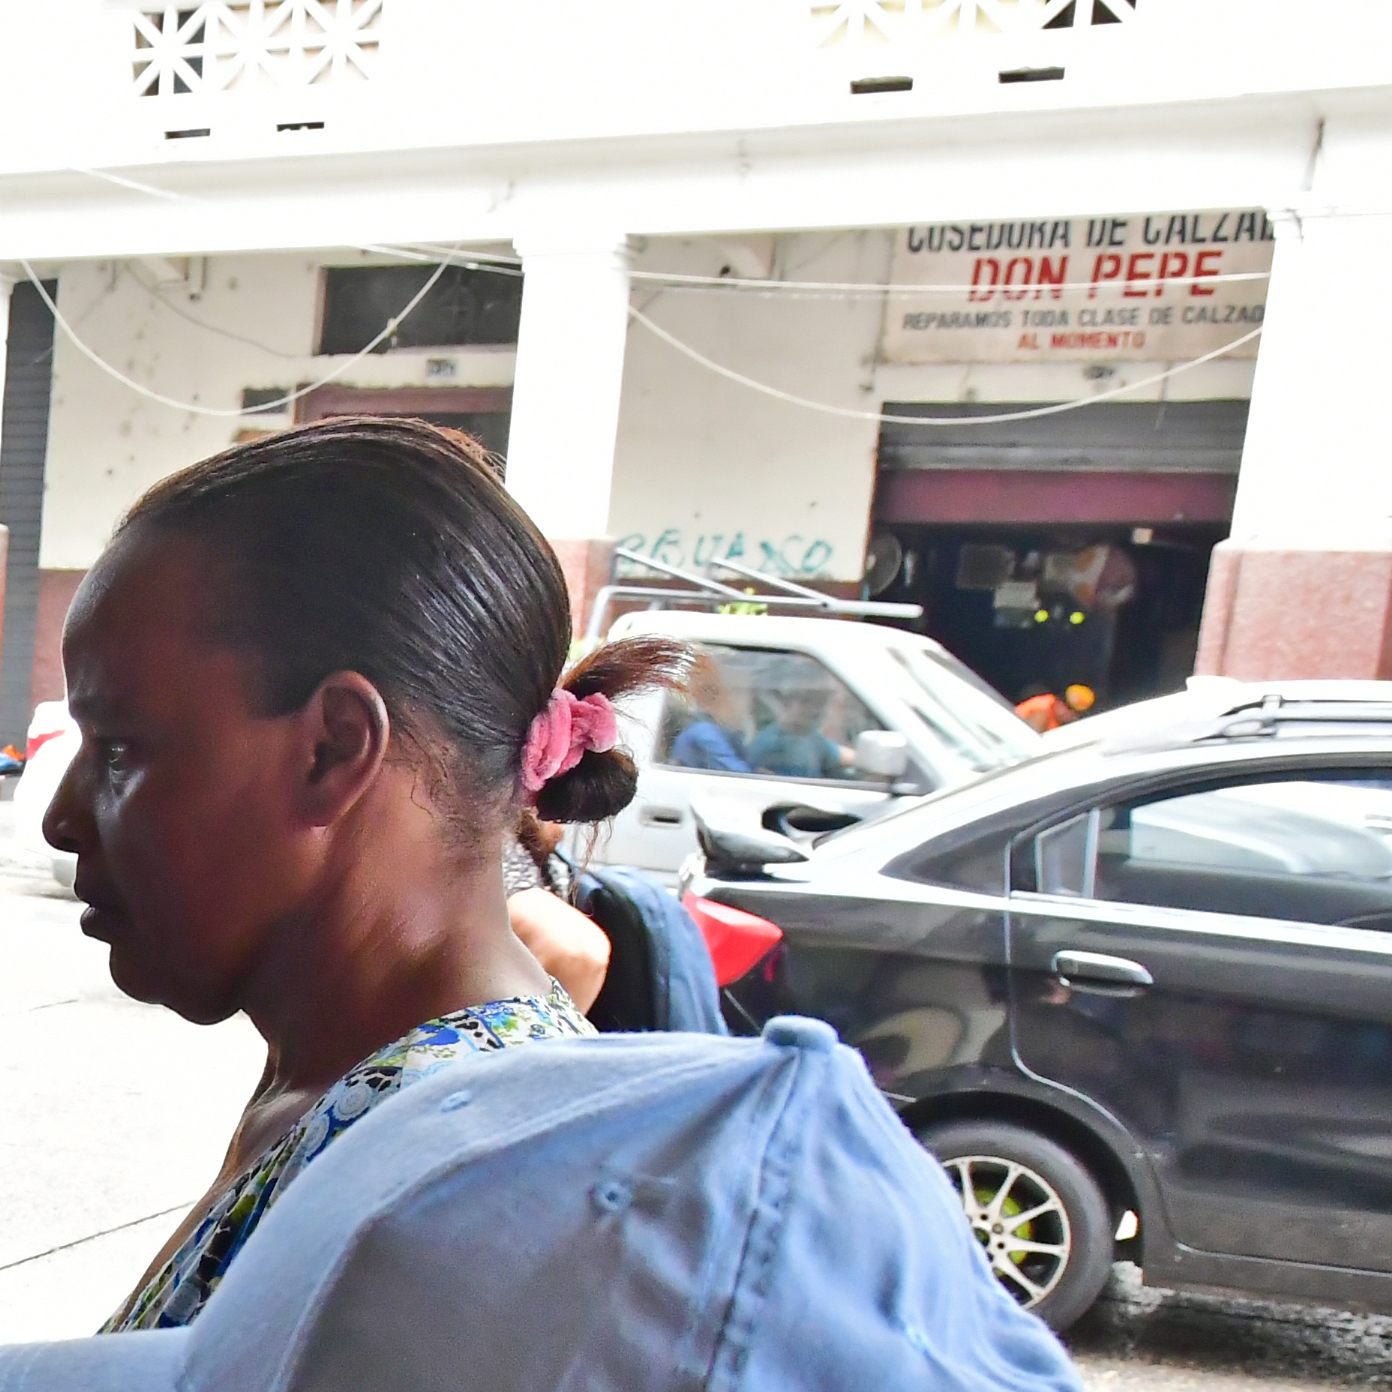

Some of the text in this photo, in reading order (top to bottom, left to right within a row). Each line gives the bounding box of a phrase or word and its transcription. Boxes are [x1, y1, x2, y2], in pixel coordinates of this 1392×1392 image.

[968, 250, 1224, 303] DON PEPE
[903, 308, 1012, 331] REPARAMOS
[1023, 307, 1070, 329] TODA
[1078, 306, 1141, 328] CLASE
[1149, 306, 1175, 326] DE
[1017, 330, 1147, 351] AL MOMENTO
